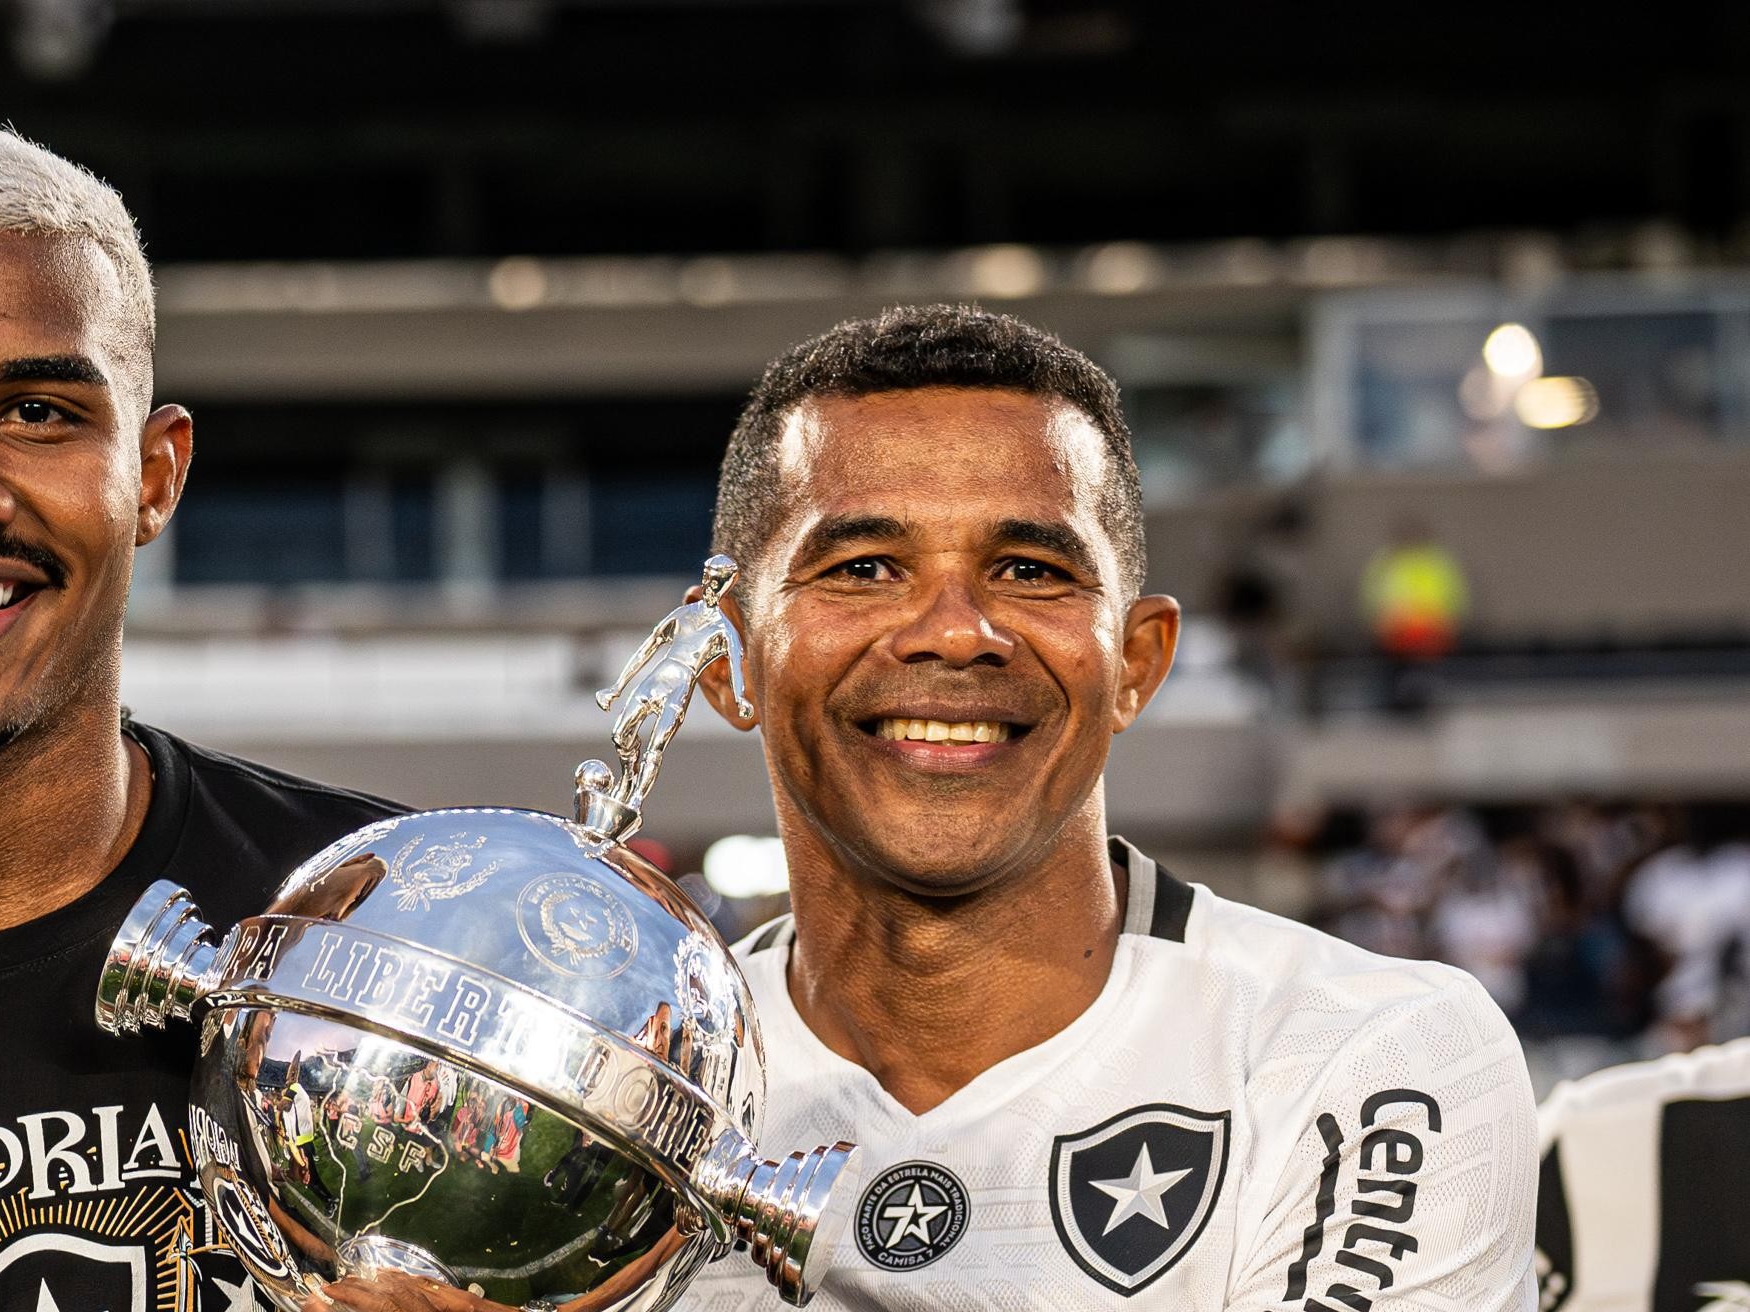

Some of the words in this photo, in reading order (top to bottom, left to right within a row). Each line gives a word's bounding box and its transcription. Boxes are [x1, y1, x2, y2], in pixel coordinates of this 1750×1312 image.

[887, 1168, 929, 1184] ESTRELA
[930, 1170, 952, 1189] MAIS
[874, 1180, 889, 1195] DA
[861, 1193, 878, 1224] PARTE
[939, 1186, 964, 1248] TRADICIONAL
[877, 1251, 925, 1266] CAMISA
[926, 1249, 934, 1258] 7
